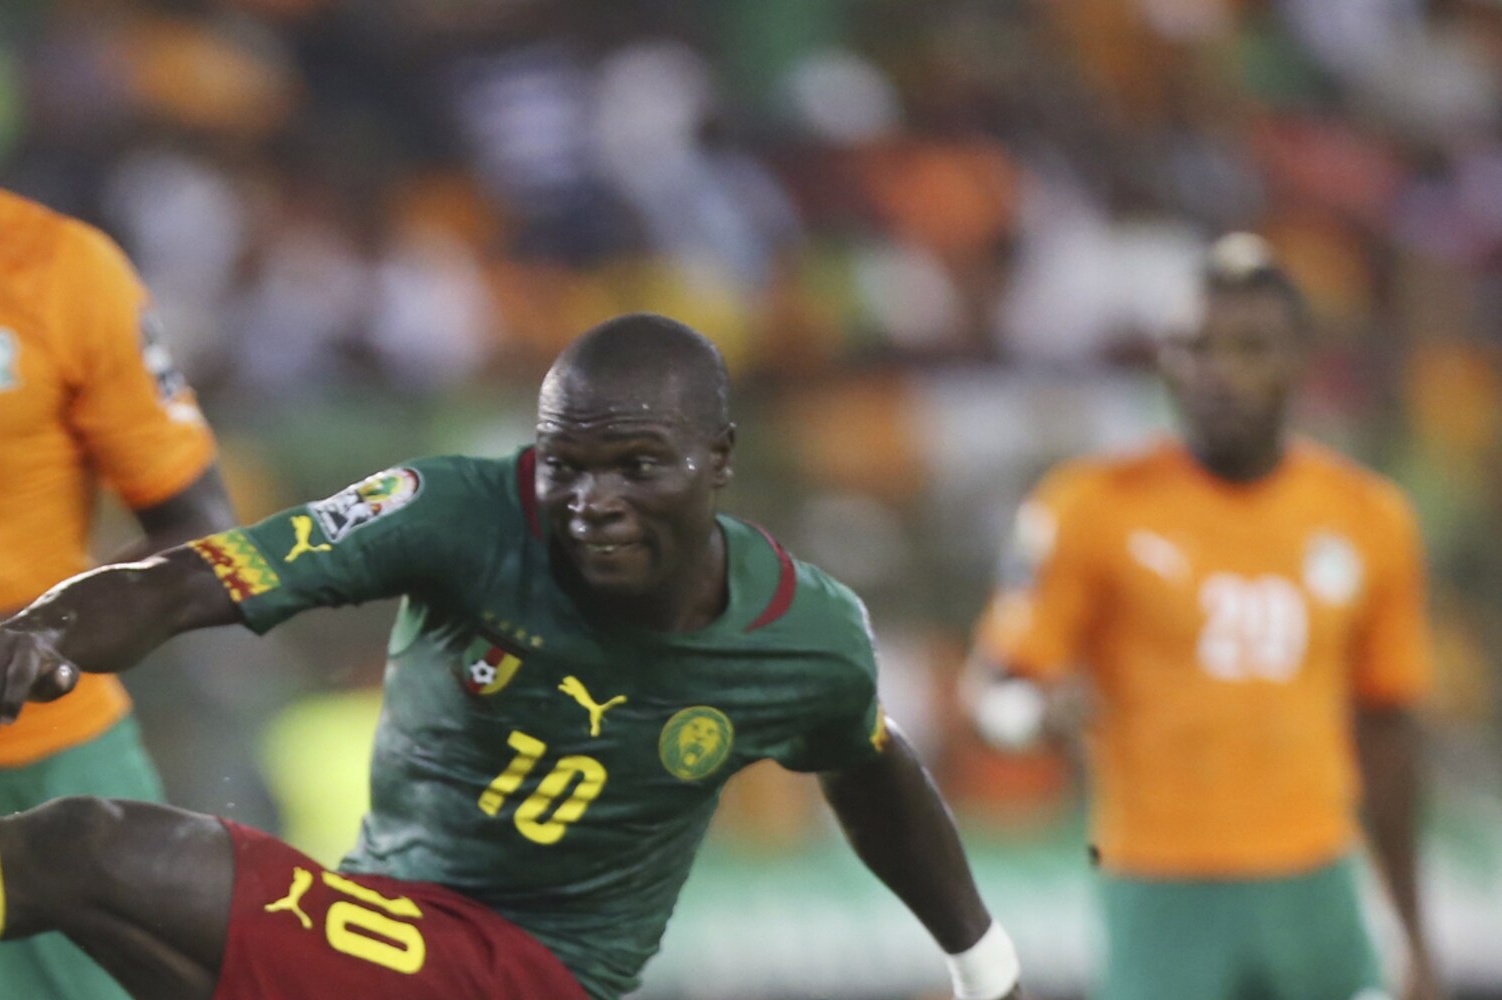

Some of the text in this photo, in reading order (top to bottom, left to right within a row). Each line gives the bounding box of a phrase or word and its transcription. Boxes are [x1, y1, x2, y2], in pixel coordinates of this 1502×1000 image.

[1197, 572, 1308, 682] 20
[477, 730, 607, 845] 10
[322, 870, 426, 974] 10
